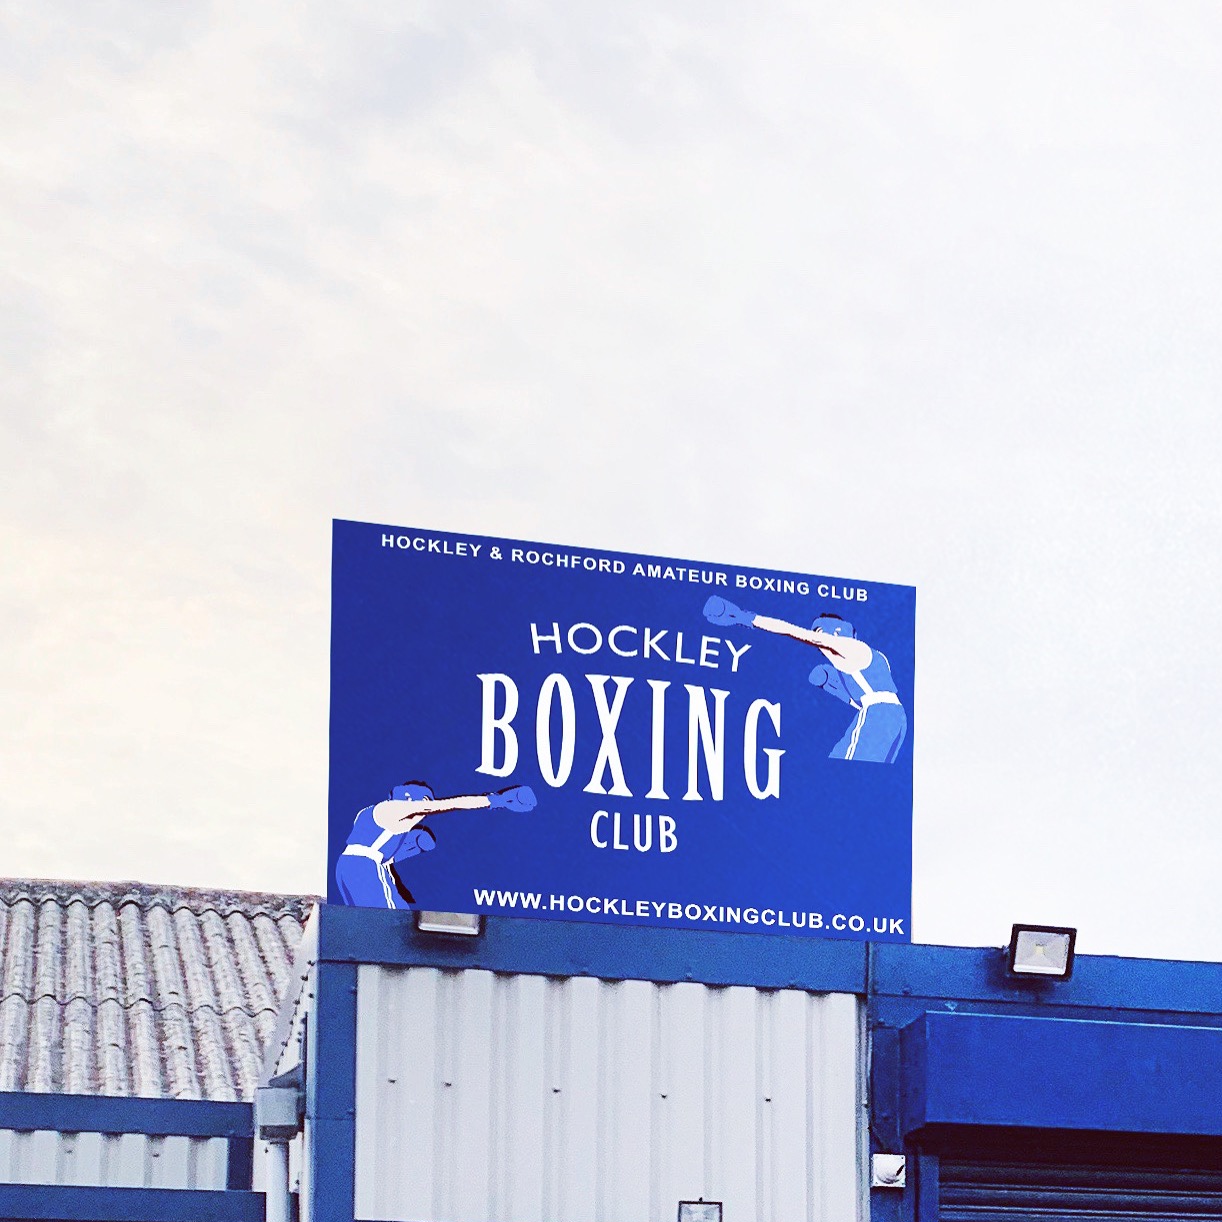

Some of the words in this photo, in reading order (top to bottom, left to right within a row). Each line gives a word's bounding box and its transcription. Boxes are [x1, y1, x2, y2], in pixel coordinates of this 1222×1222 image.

[381, 533, 482, 560] HOCKLEY
[489, 546, 503, 560] &
[511, 548, 626, 574] ROCHFORD
[632, 563, 728, 586] AMATEUR
[735, 574, 810, 595] BOXING
[817, 584, 868, 602] CLUB
[530, 622, 752, 673] HOCKLEY
[474, 672, 786, 801] BOXING
[590, 810, 678, 853] CLUB
[473, 888, 905, 935] WWW.HOCKLEYBOXINGCLUB.CO.UK
